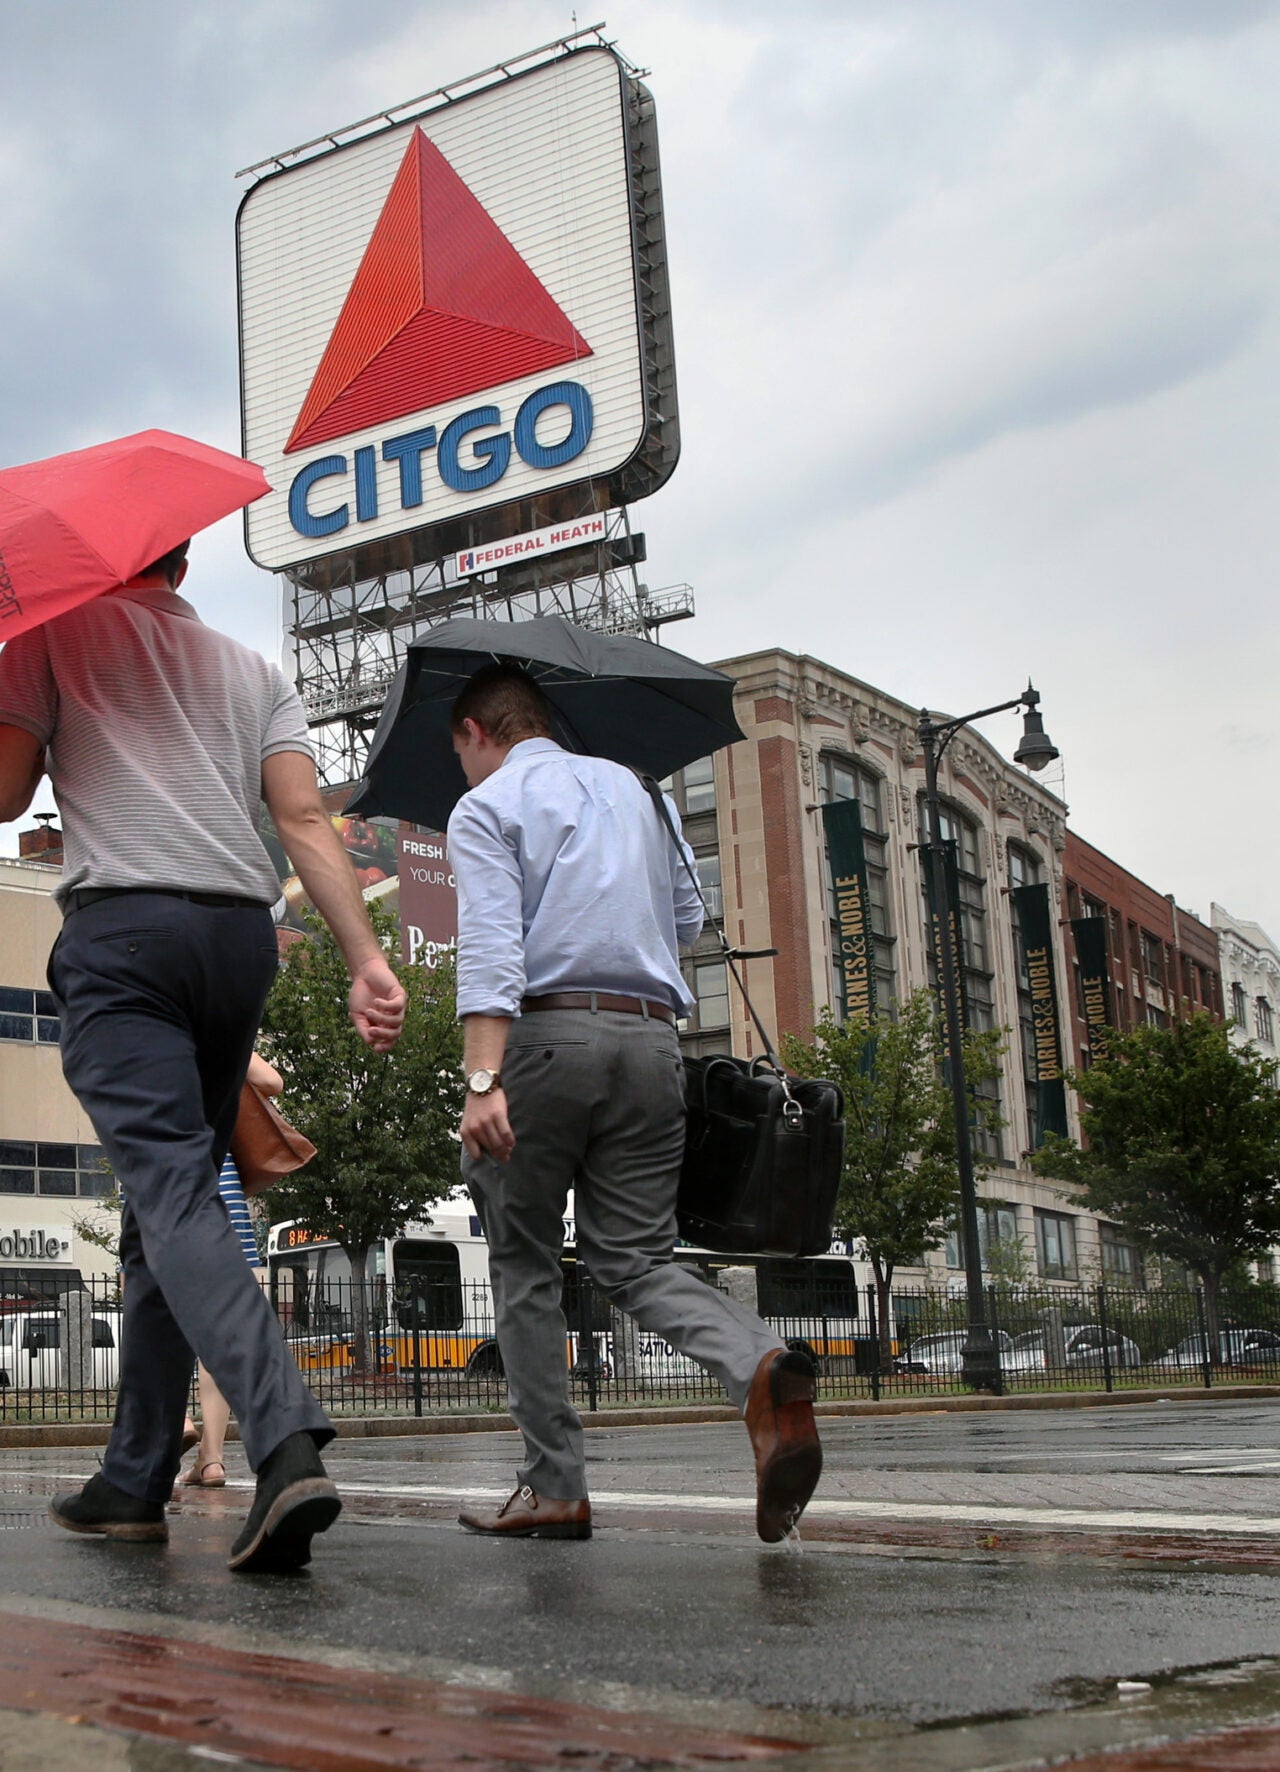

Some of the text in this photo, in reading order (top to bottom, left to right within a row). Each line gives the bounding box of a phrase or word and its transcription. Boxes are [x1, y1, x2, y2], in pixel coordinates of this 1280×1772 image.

[288, 381, 594, 538] CITGO
[476, 537, 544, 565] FEDERAL
[550, 520, 603, 544] HEATH
[402, 839, 444, 860] FRESH
[409, 866, 446, 886] YOUR
[289, 1230, 295, 1247] 8
